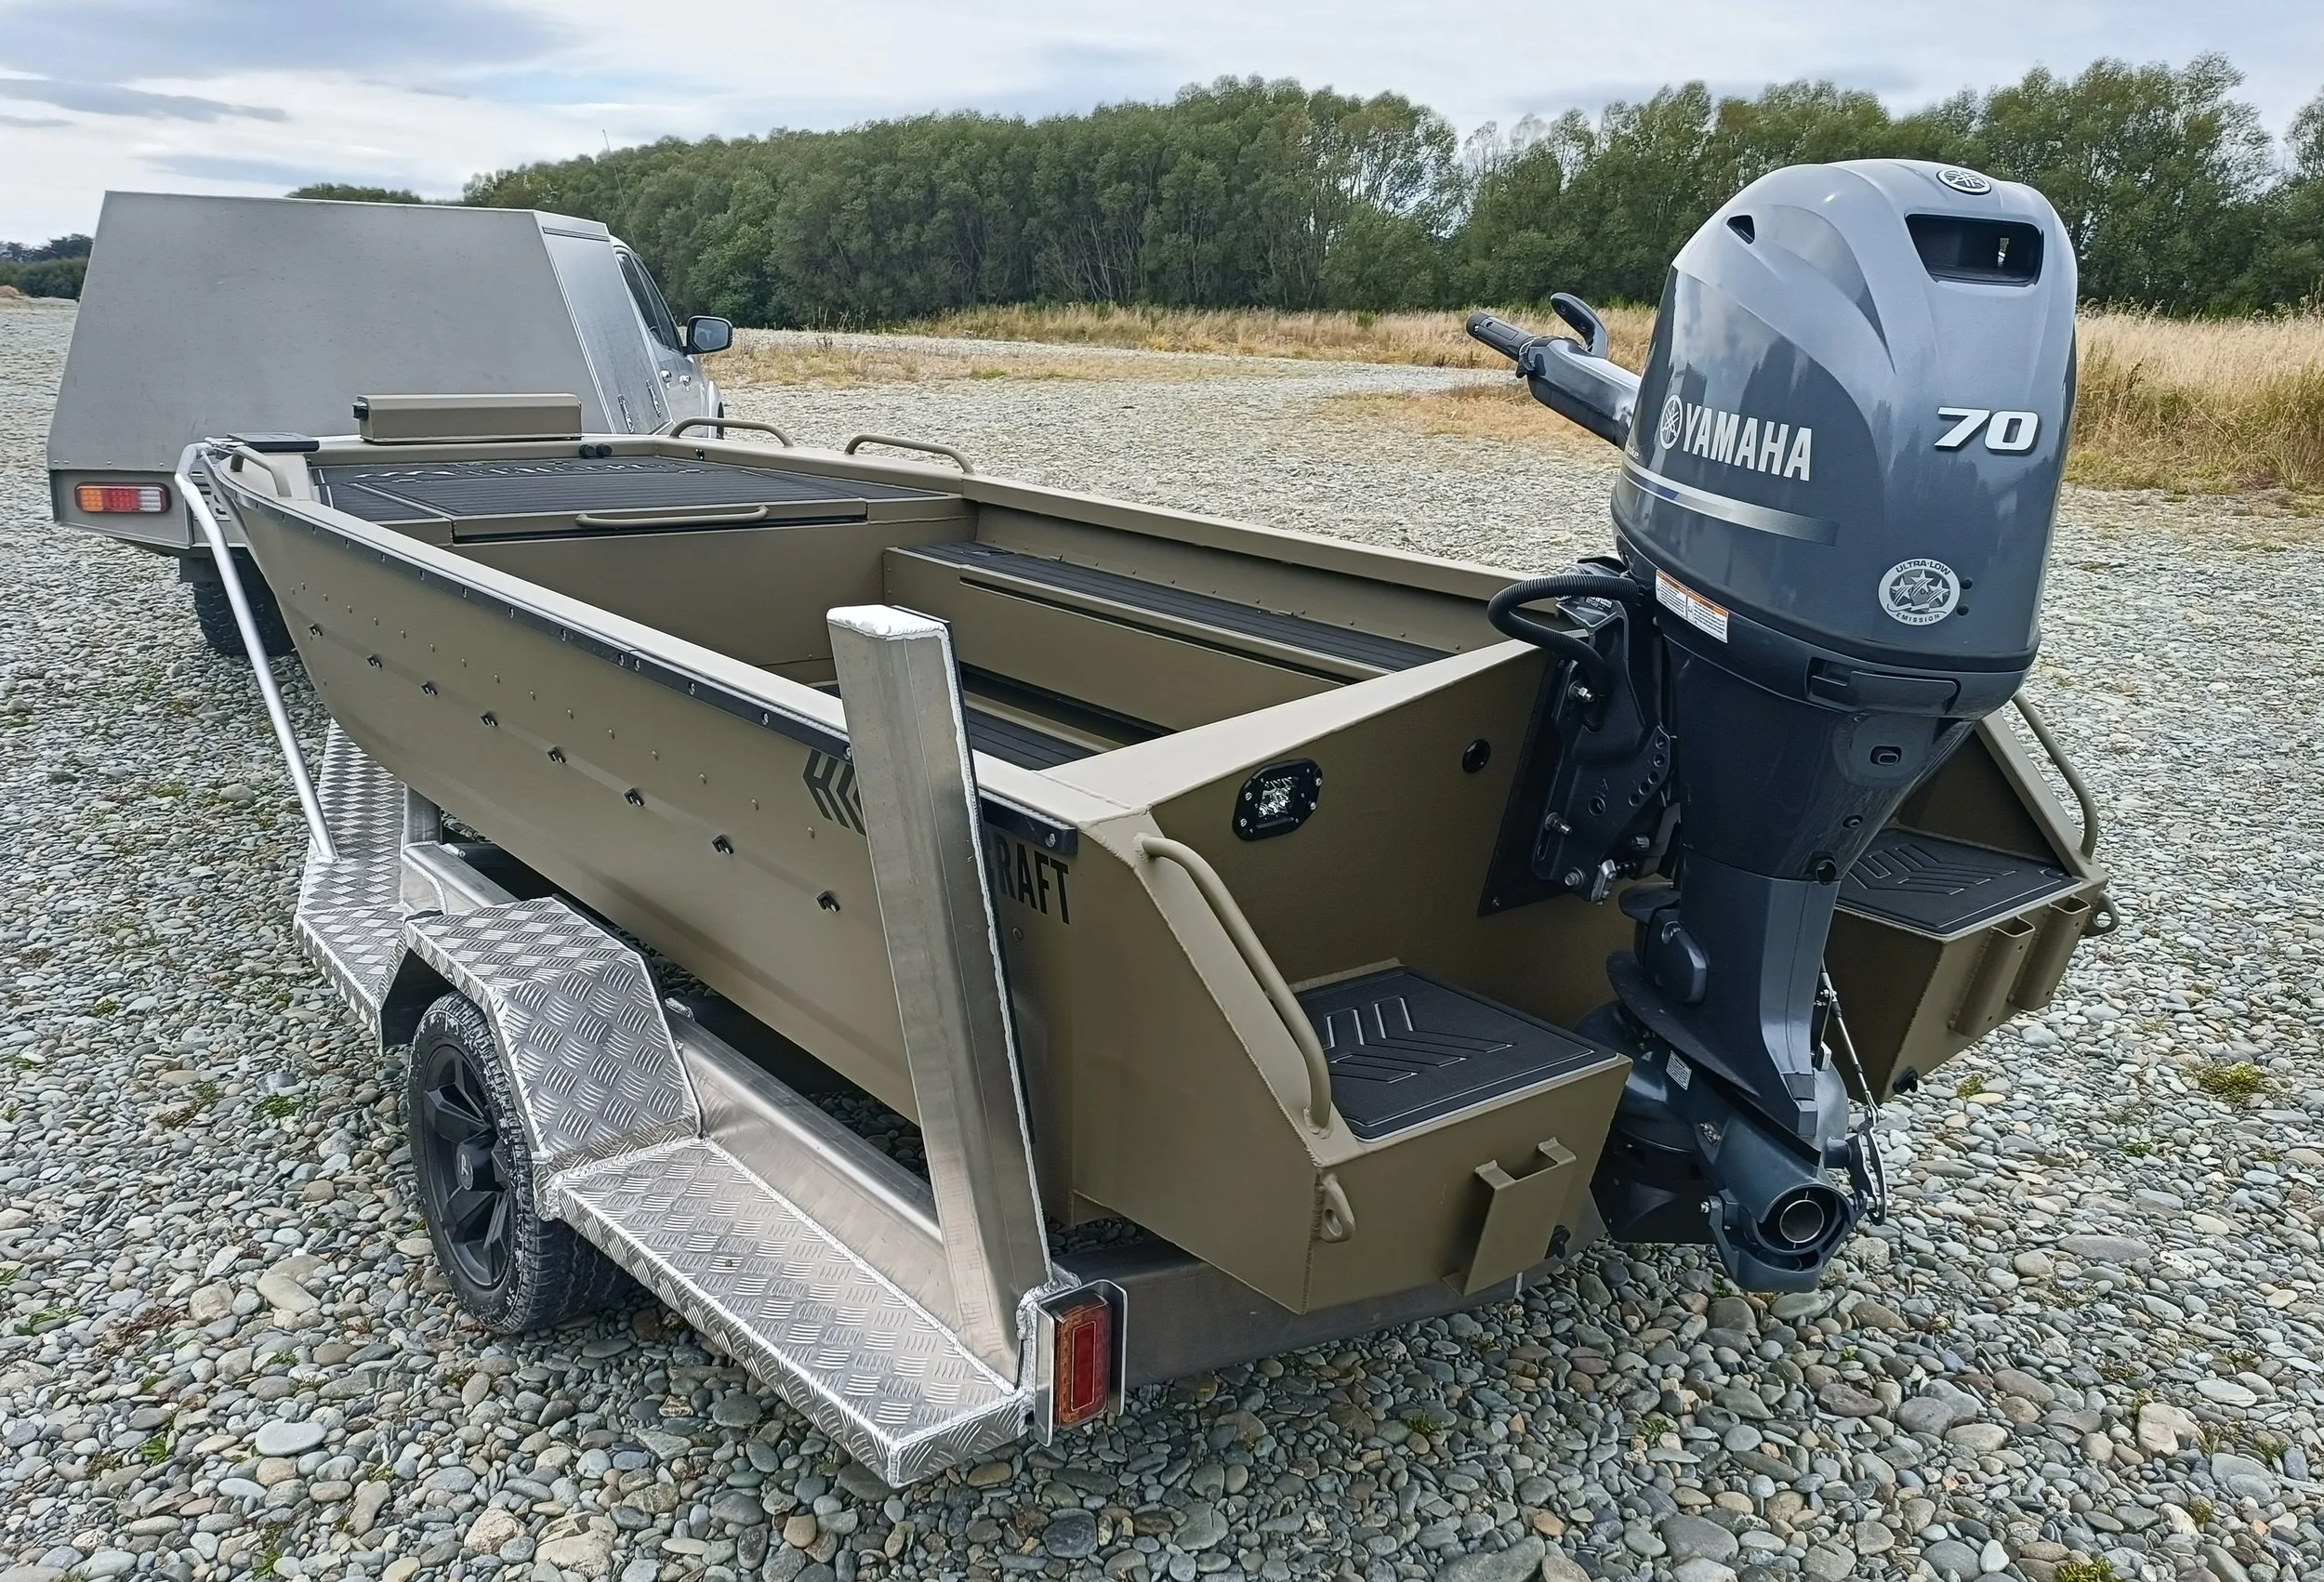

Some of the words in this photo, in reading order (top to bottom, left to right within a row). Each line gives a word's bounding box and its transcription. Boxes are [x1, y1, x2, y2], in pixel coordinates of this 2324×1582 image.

[1683, 402, 1813, 481] YAMAHA
[1934, 406, 2039, 451] 70
[1896, 612, 1940, 623] EMISSION
[986, 833, 1069, 925] RAFT
